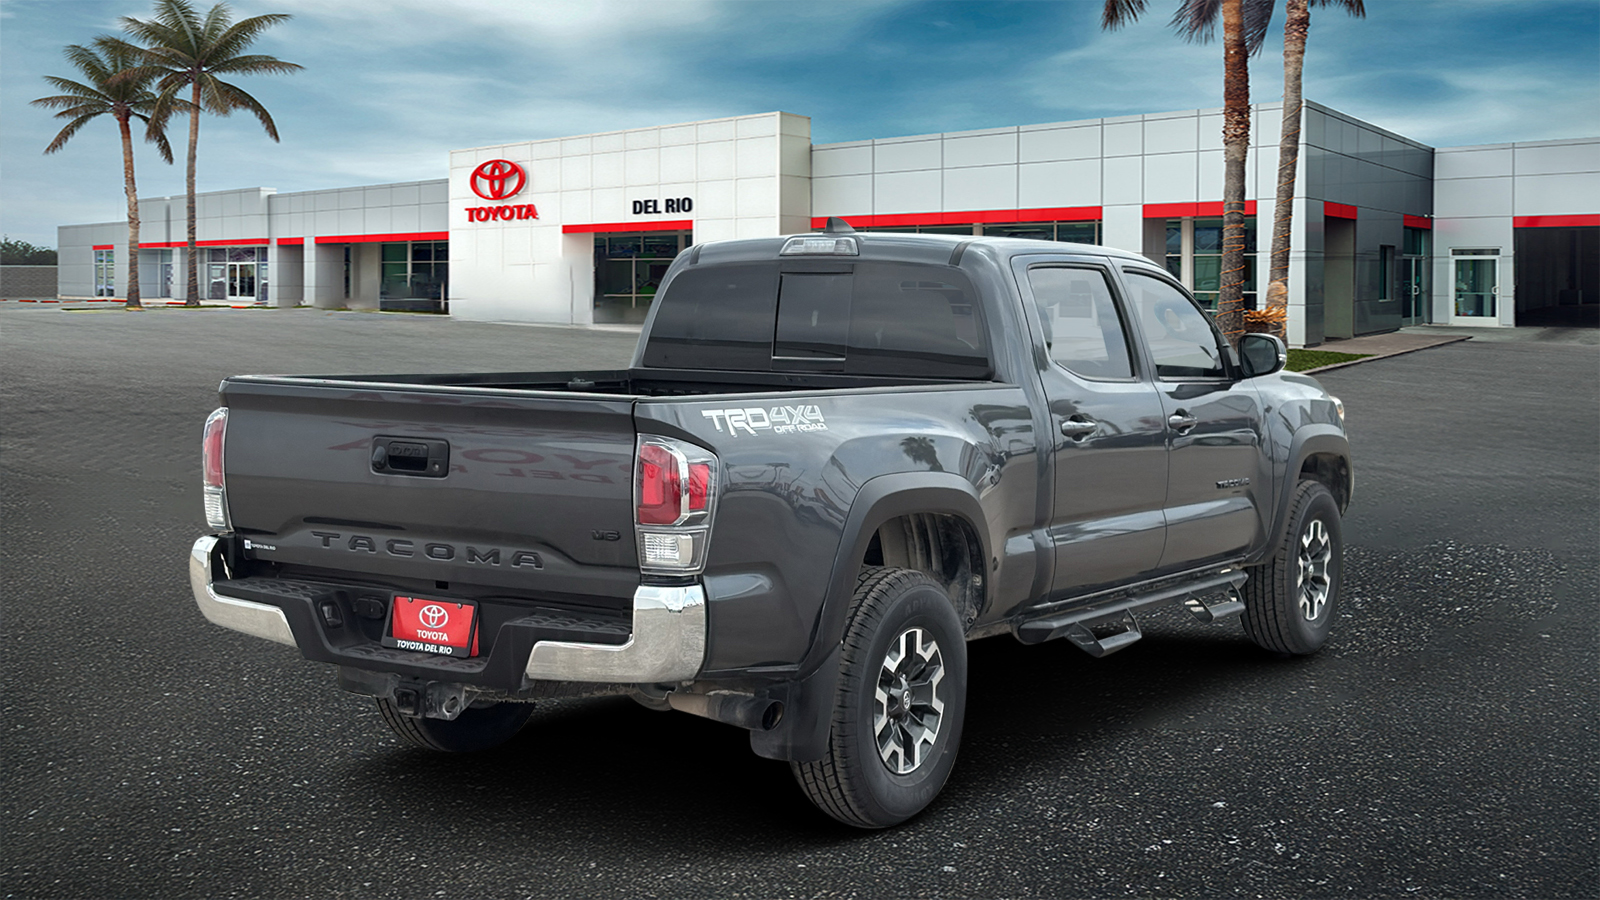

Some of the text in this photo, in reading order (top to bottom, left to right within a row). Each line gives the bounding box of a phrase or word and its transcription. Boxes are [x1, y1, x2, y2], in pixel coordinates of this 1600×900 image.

[465, 204, 539, 222] TOYOTA
[633, 197, 693, 215] DEL RIO
[701, 405, 824, 437] TRD 4X4
[774, 423, 828, 434] OFF ROAD
[592, 530, 621, 541] V6
[311, 530, 544, 570] TACOMA
[417, 629, 449, 642] TOYOTA
[397, 640, 452, 655] TOYOTA DEL RIO
